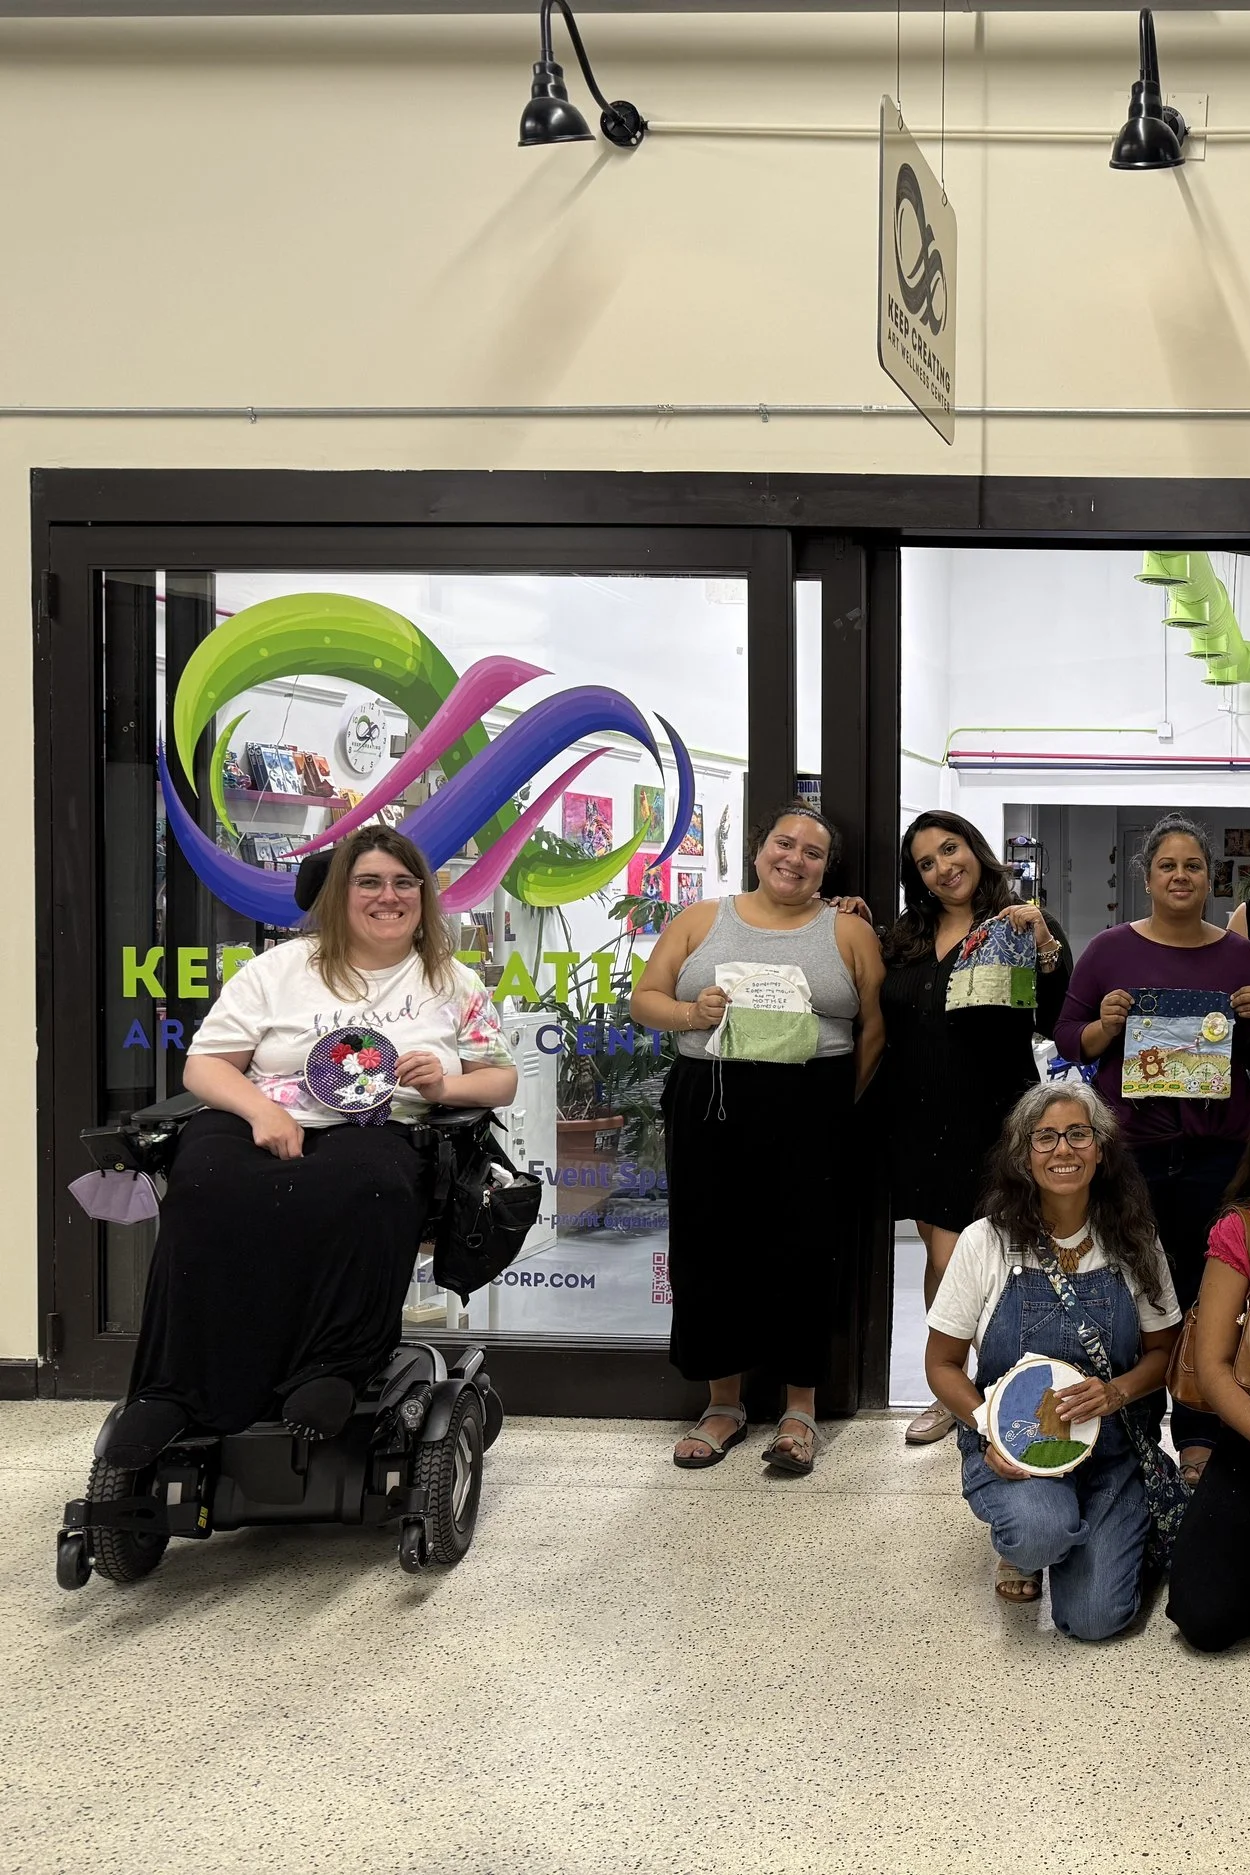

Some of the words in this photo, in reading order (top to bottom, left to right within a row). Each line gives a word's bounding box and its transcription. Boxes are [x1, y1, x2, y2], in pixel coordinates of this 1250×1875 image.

[887, 328, 900, 351] ART
[901, 343, 930, 390] WELLNESS
[930, 382, 951, 415] CENTER
[888, 294, 910, 338] KEEP
[911, 327, 951, 394] CREATING
